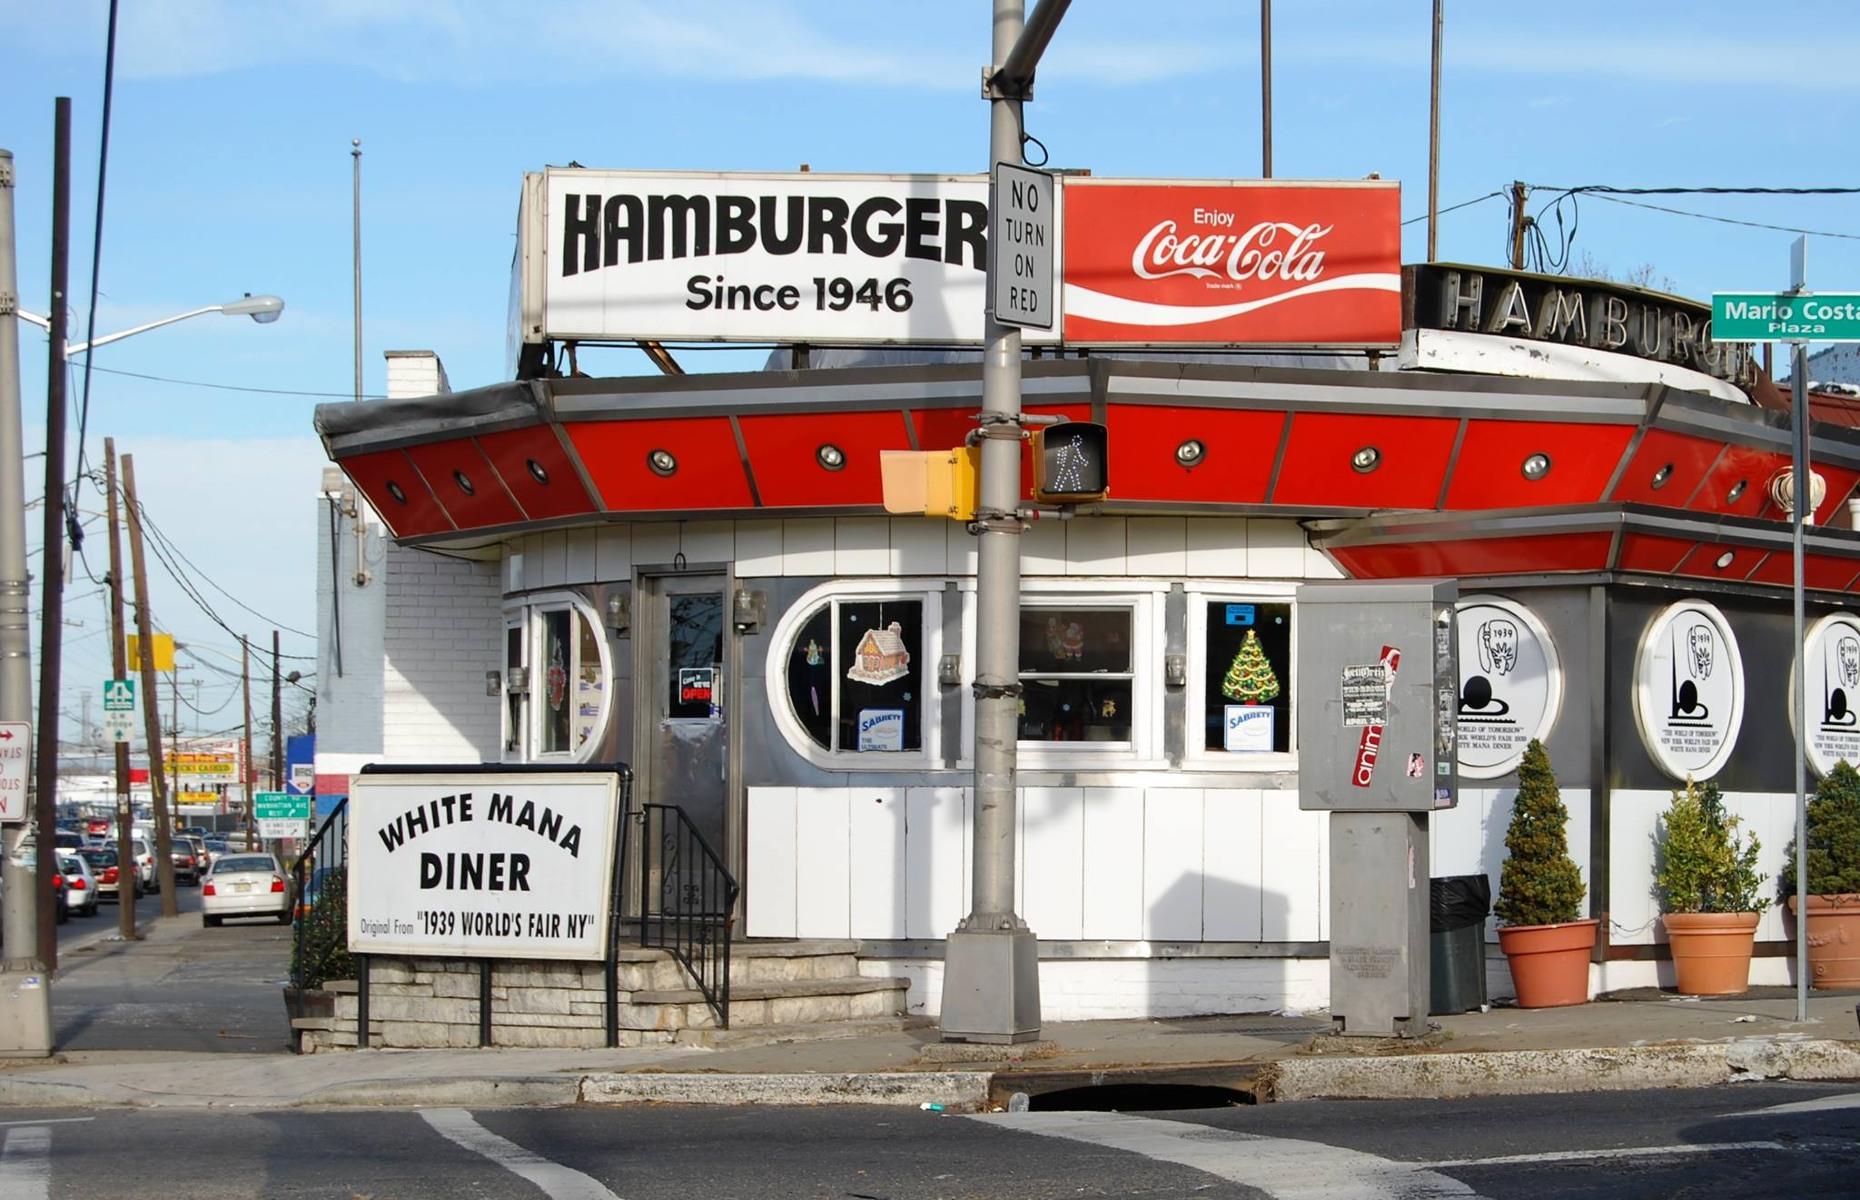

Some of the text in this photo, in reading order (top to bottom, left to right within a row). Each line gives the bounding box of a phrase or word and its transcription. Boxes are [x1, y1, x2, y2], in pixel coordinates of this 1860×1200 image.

[1012, 179, 1039, 213] NO
[1193, 208, 1235, 228] Enjoy
[562, 193, 989, 277] HAMBURGER
[1006, 218, 1044, 247] TURN
[1131, 220, 1334, 281] Coca-Cola
[1015, 254, 1034, 279] ON
[686, 275, 914, 312] Since 1946
[1010, 286, 1038, 313] RED
[1725, 301, 1860, 321] Mario Costa
[1768, 322, 1825, 333] Plaza
[1494, 628, 1513, 638] 1939
[683, 688, 712, 700] OPEN
[862, 714, 901, 731] SABRETT
[1229, 711, 1271, 729] SABRETT
[378, 793, 582, 858] WHITE MANA
[420, 852, 531, 891] DINER
[360, 910, 594, 939] Original From "1939 WORLD'S FAIR NY"
